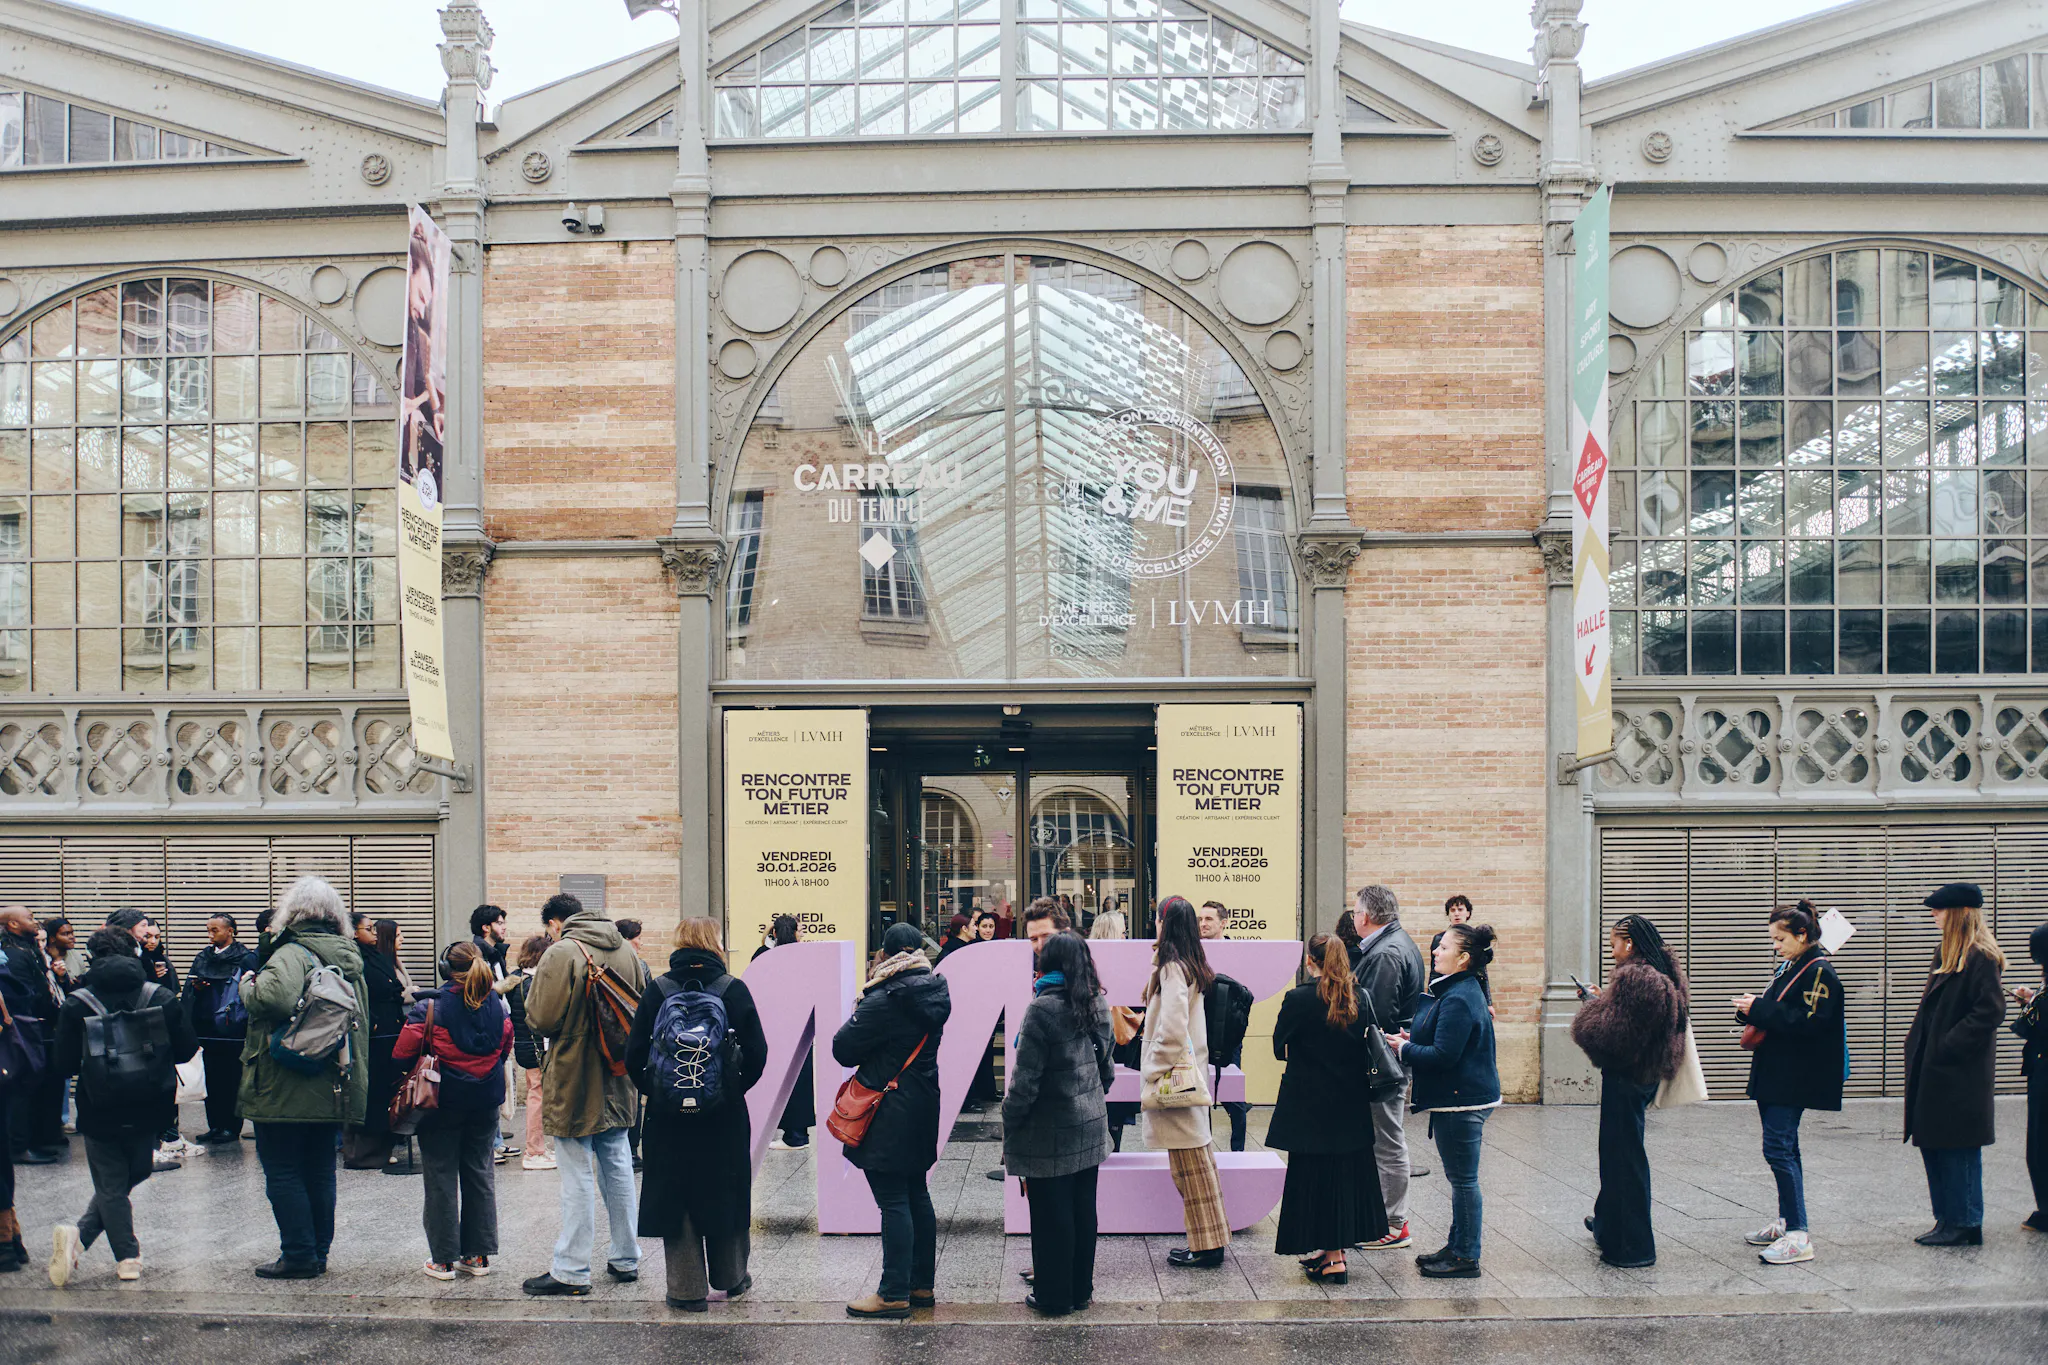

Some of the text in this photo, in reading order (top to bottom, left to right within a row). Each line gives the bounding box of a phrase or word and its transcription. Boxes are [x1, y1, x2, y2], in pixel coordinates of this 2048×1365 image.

[1580, 318, 1602, 349] SPORT
[1577, 339, 1605, 375] CULTURE
[868, 431, 887, 456] LE
[1145, 409, 1231, 476] D'ORIENTATION
[793, 463, 962, 491] CARREAU
[1110, 453, 1198, 496] YOU
[828, 498, 928, 523] DU TEMPLE
[1209, 496, 1232, 538] LVMH
[401, 507, 439, 536] RENCONTRE
[402, 518, 437, 546] TON FUTUR
[407, 585, 435, 606] VENDREDI
[406, 594, 437, 616] 30.01.2026
[1168, 600, 1273, 625] LVMH
[1039, 614, 1137, 627] D'EXCELLENCE
[1577, 609, 1605, 639] HALLE
[414, 650, 434, 665] SAMEDI
[410, 658, 440, 676] 31.01.2026
[801, 731, 843, 742] LVMH
[1234, 726, 1275, 736] LVMH
[741, 773, 851, 786] RENCONTRE
[1173, 768, 1284, 781] RENCONTRE
[745, 788, 847, 800] TON FUTUR
[1176, 783, 1280, 795] TON FUTUR
[764, 801, 829, 815] MÉTIER
[1195, 796, 1261, 810] MÉTIER
[762, 851, 832, 861] VENDREDI
[1192, 847, 1263, 857] VENDREDI
[756, 863, 837, 872] 30.01.2026
[1187, 858, 1268, 868] 30.01.2026
[764, 876, 829, 887] 11H00 À 18H00
[1195, 872, 1261, 882] 11H00 À 18H00
[759, 924, 836, 933] 32026
